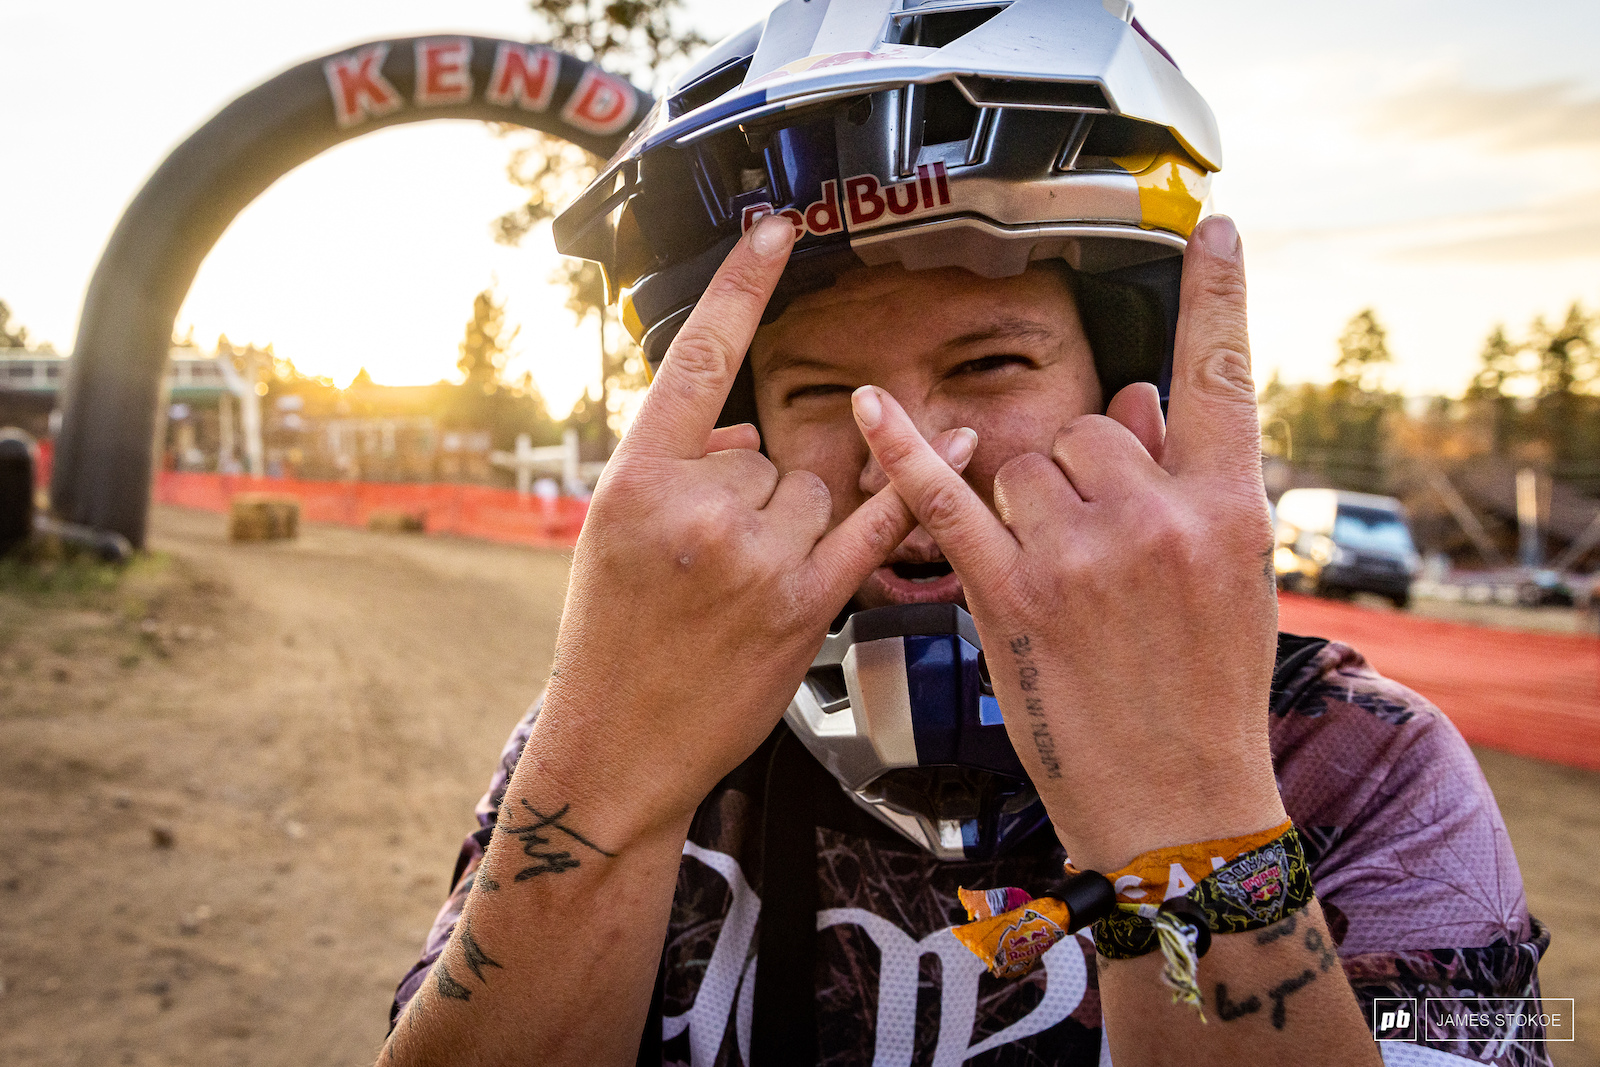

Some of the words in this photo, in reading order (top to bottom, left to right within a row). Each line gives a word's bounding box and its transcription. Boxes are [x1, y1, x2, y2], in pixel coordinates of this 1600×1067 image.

[324, 38, 638, 135] KEND
[844, 160, 950, 229] Bull
[1026, 698, 1045, 717] IN
